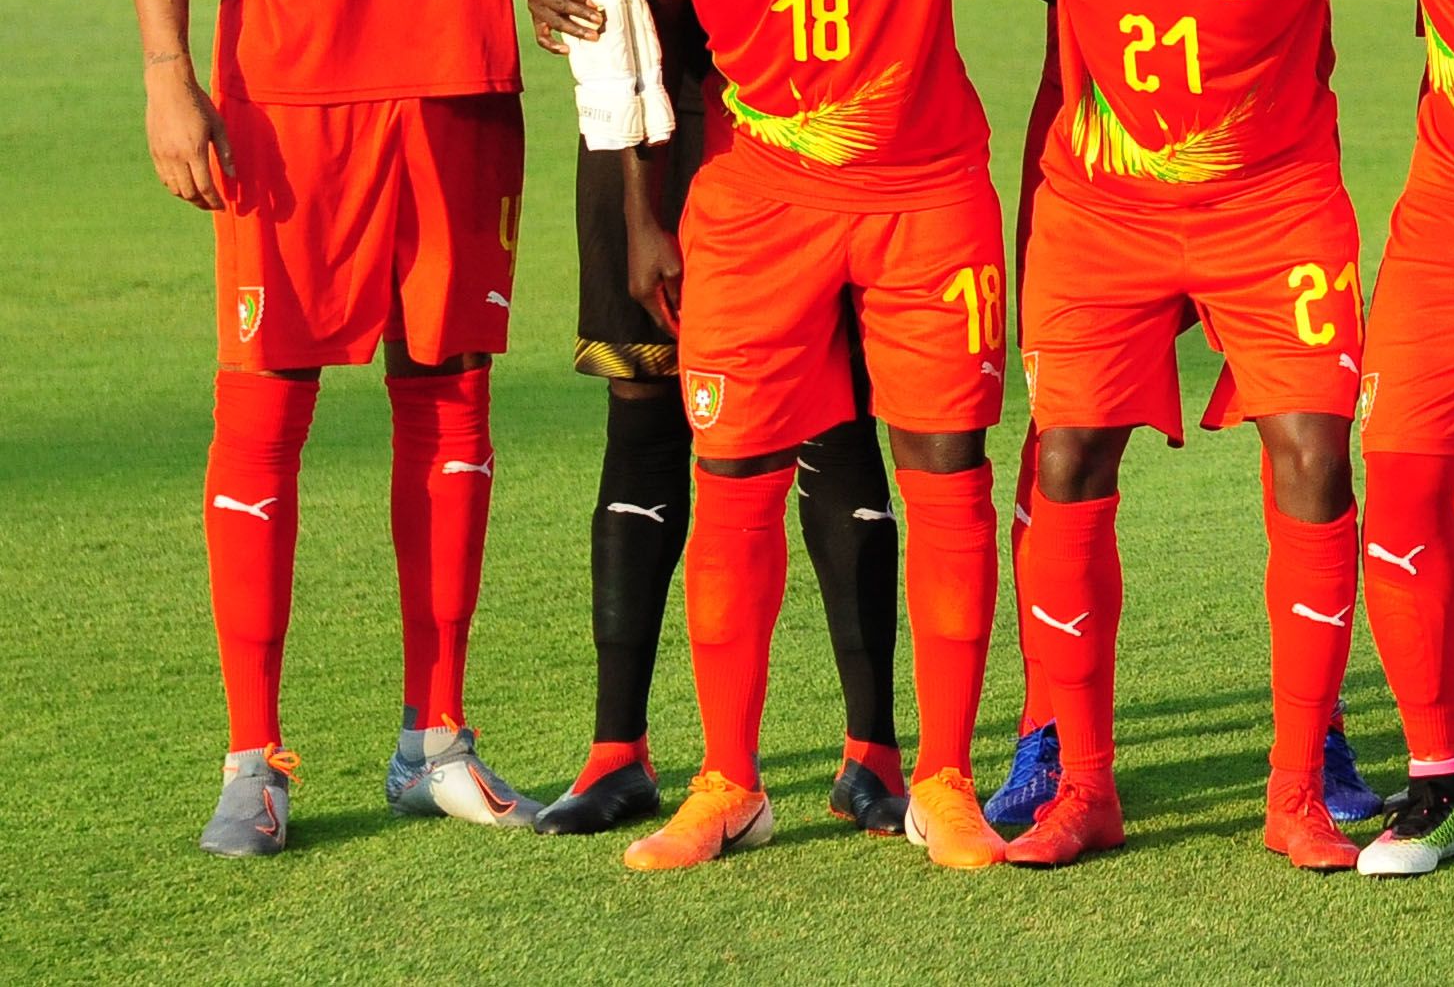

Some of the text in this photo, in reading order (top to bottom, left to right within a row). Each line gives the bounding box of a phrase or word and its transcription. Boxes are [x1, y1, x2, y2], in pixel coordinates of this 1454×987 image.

[1119, 13, 1203, 94] 21
[942, 264, 1003, 355] 18
[1288, 262, 1362, 347] 21
